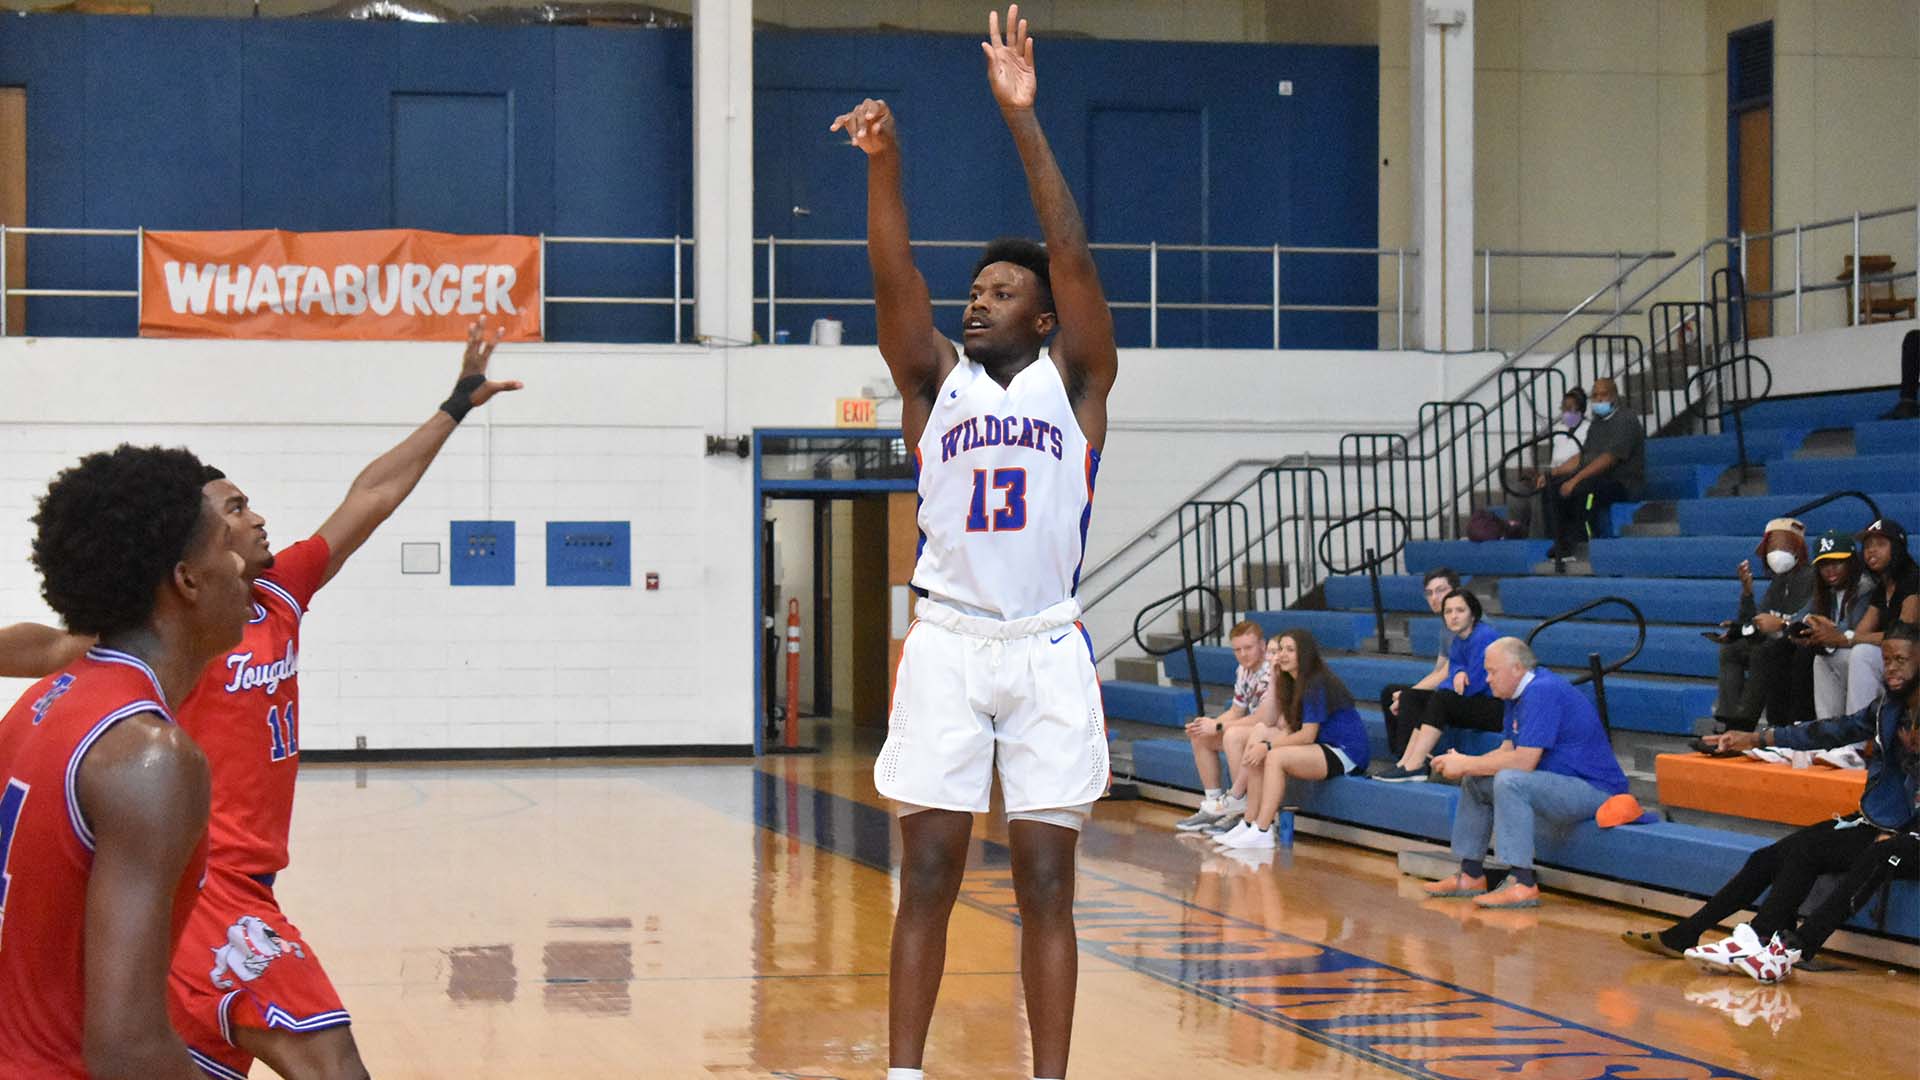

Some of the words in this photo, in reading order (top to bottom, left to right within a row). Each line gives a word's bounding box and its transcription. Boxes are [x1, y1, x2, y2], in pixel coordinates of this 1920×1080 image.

[164, 261, 517, 316] WHATABURGER
[842, 399, 871, 423] EXIT
[941, 414, 1063, 463] WILDCATS
[965, 467, 1028, 532] 13
[224, 639, 299, 695] Tougal
[266, 700, 298, 762] 11
